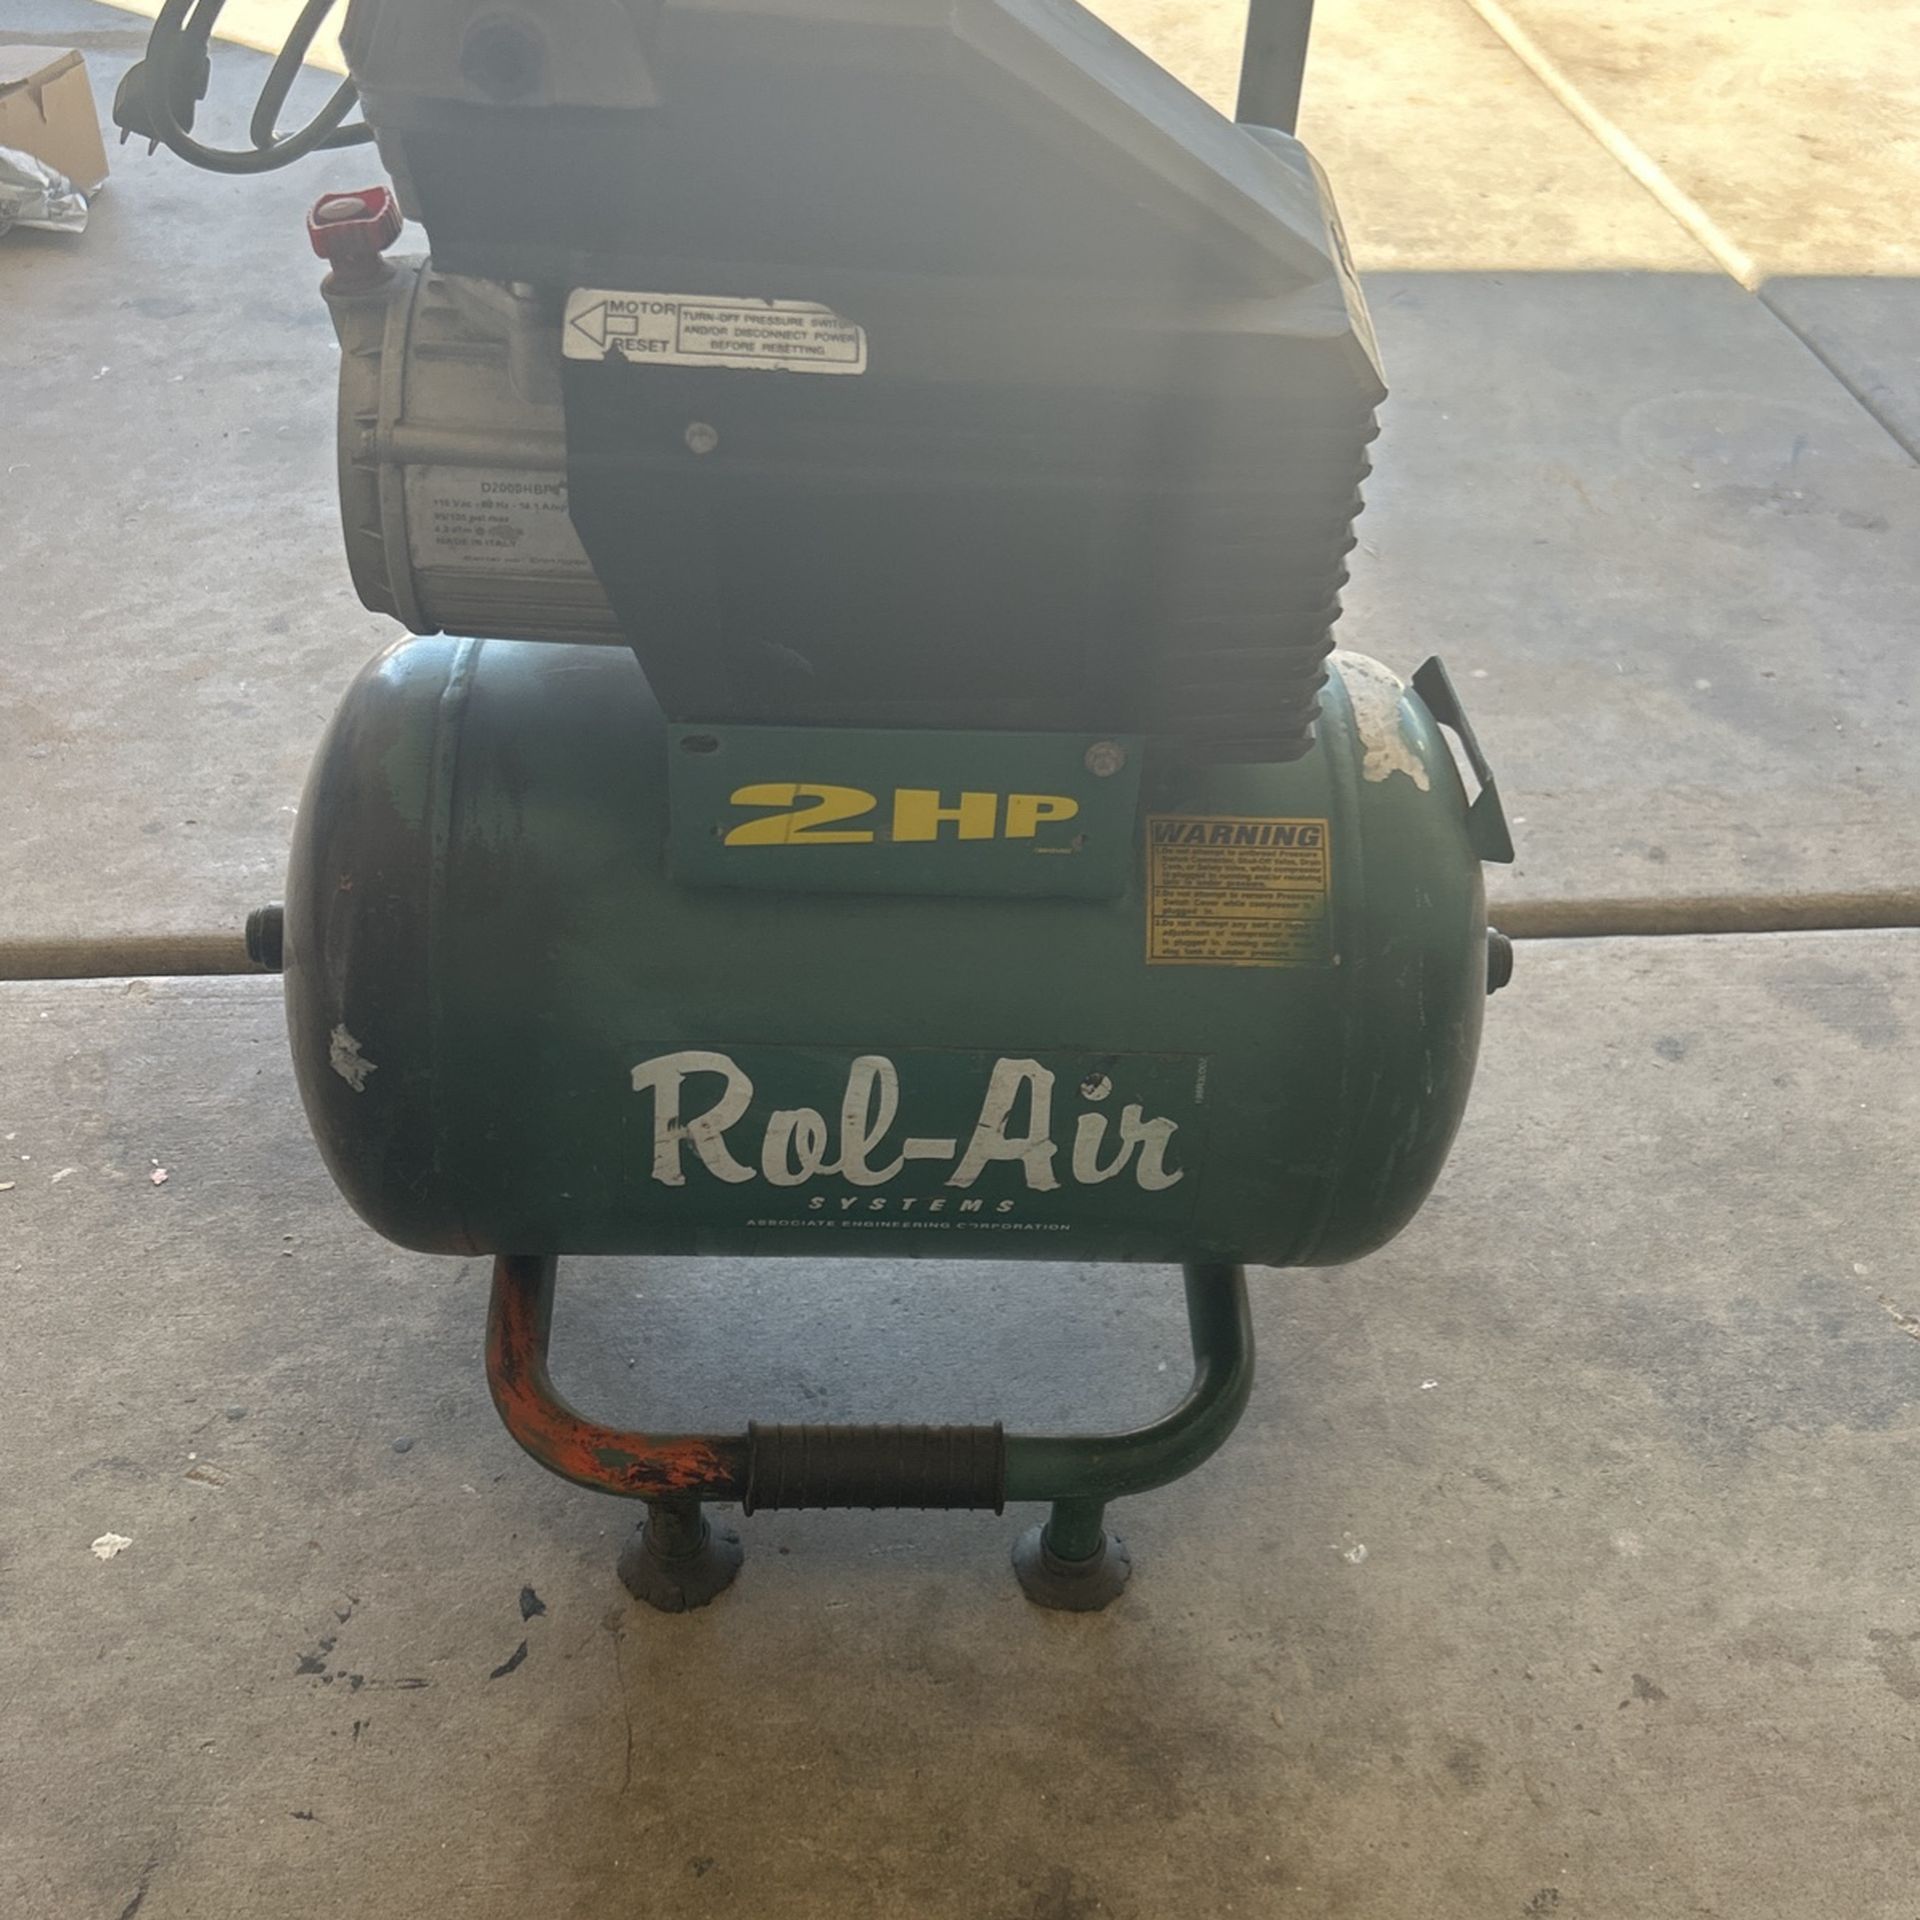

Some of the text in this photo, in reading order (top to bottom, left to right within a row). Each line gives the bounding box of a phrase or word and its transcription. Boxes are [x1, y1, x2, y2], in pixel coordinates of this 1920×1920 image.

[610, 300, 677, 315] MOTOR
[743, 314, 804, 327] PRESSURE
[684, 325, 855, 343] AND/OR DISCONNECT POWER
[612, 338, 669, 353] RESET
[711, 340, 826, 356] BEFORE RESETTING
[1154, 823, 1321, 846] WARNING
[631, 1050, 1184, 1191] Rol-Air
[808, 1196, 1015, 1213] SYSTEMS
[746, 1219, 835, 1227] ASSOCIATE
[842, 1220, 950, 1230] ENGINEERING
